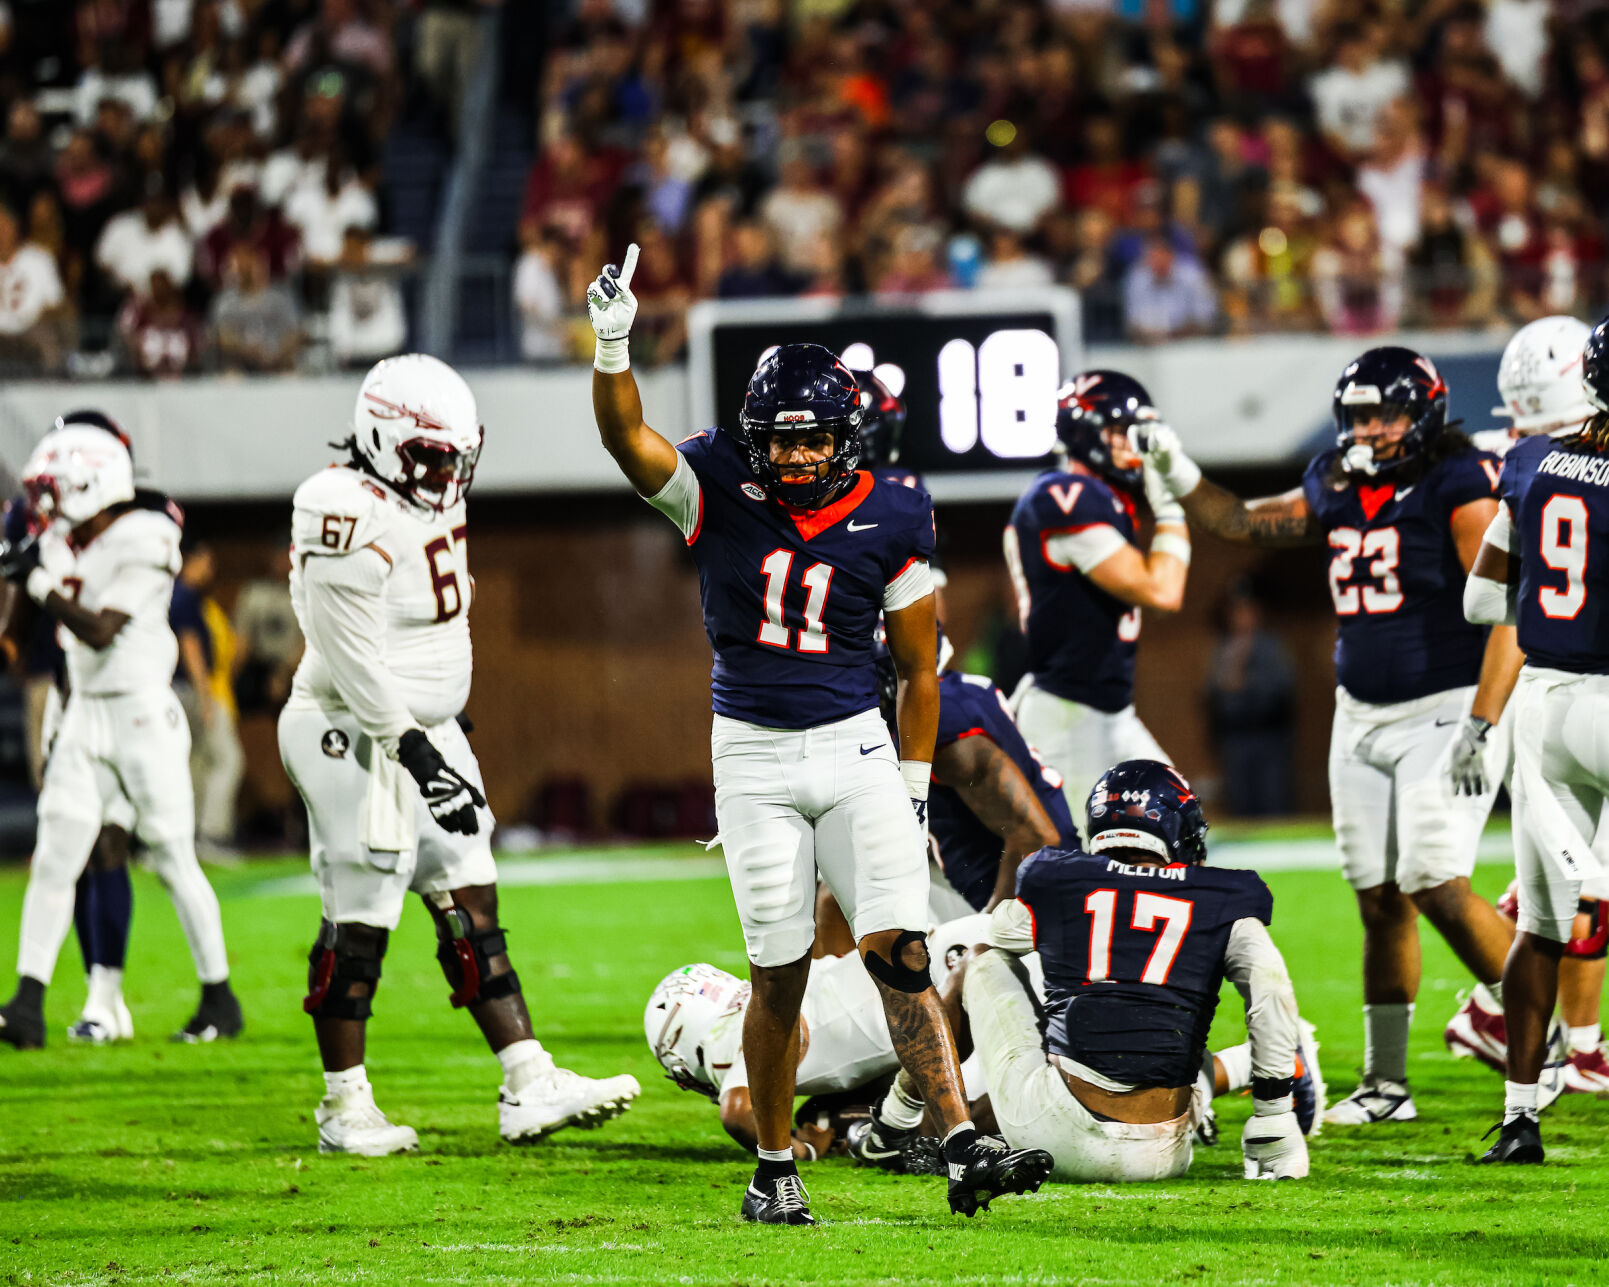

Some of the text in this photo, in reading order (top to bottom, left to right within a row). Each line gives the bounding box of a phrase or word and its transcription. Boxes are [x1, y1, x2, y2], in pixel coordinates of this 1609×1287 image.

[938, 328, 1060, 458] 18
[743, 484, 765, 499] ACC
[1048, 482, 1085, 516] V
[1537, 450, 1609, 488] ROBINSO
[321, 513, 360, 551] 67
[1537, 493, 1590, 621] 9
[757, 547, 835, 654] 11
[1327, 526, 1405, 615] 23
[1106, 859, 1187, 881] MELTON
[1083, 887, 1195, 986] 17
